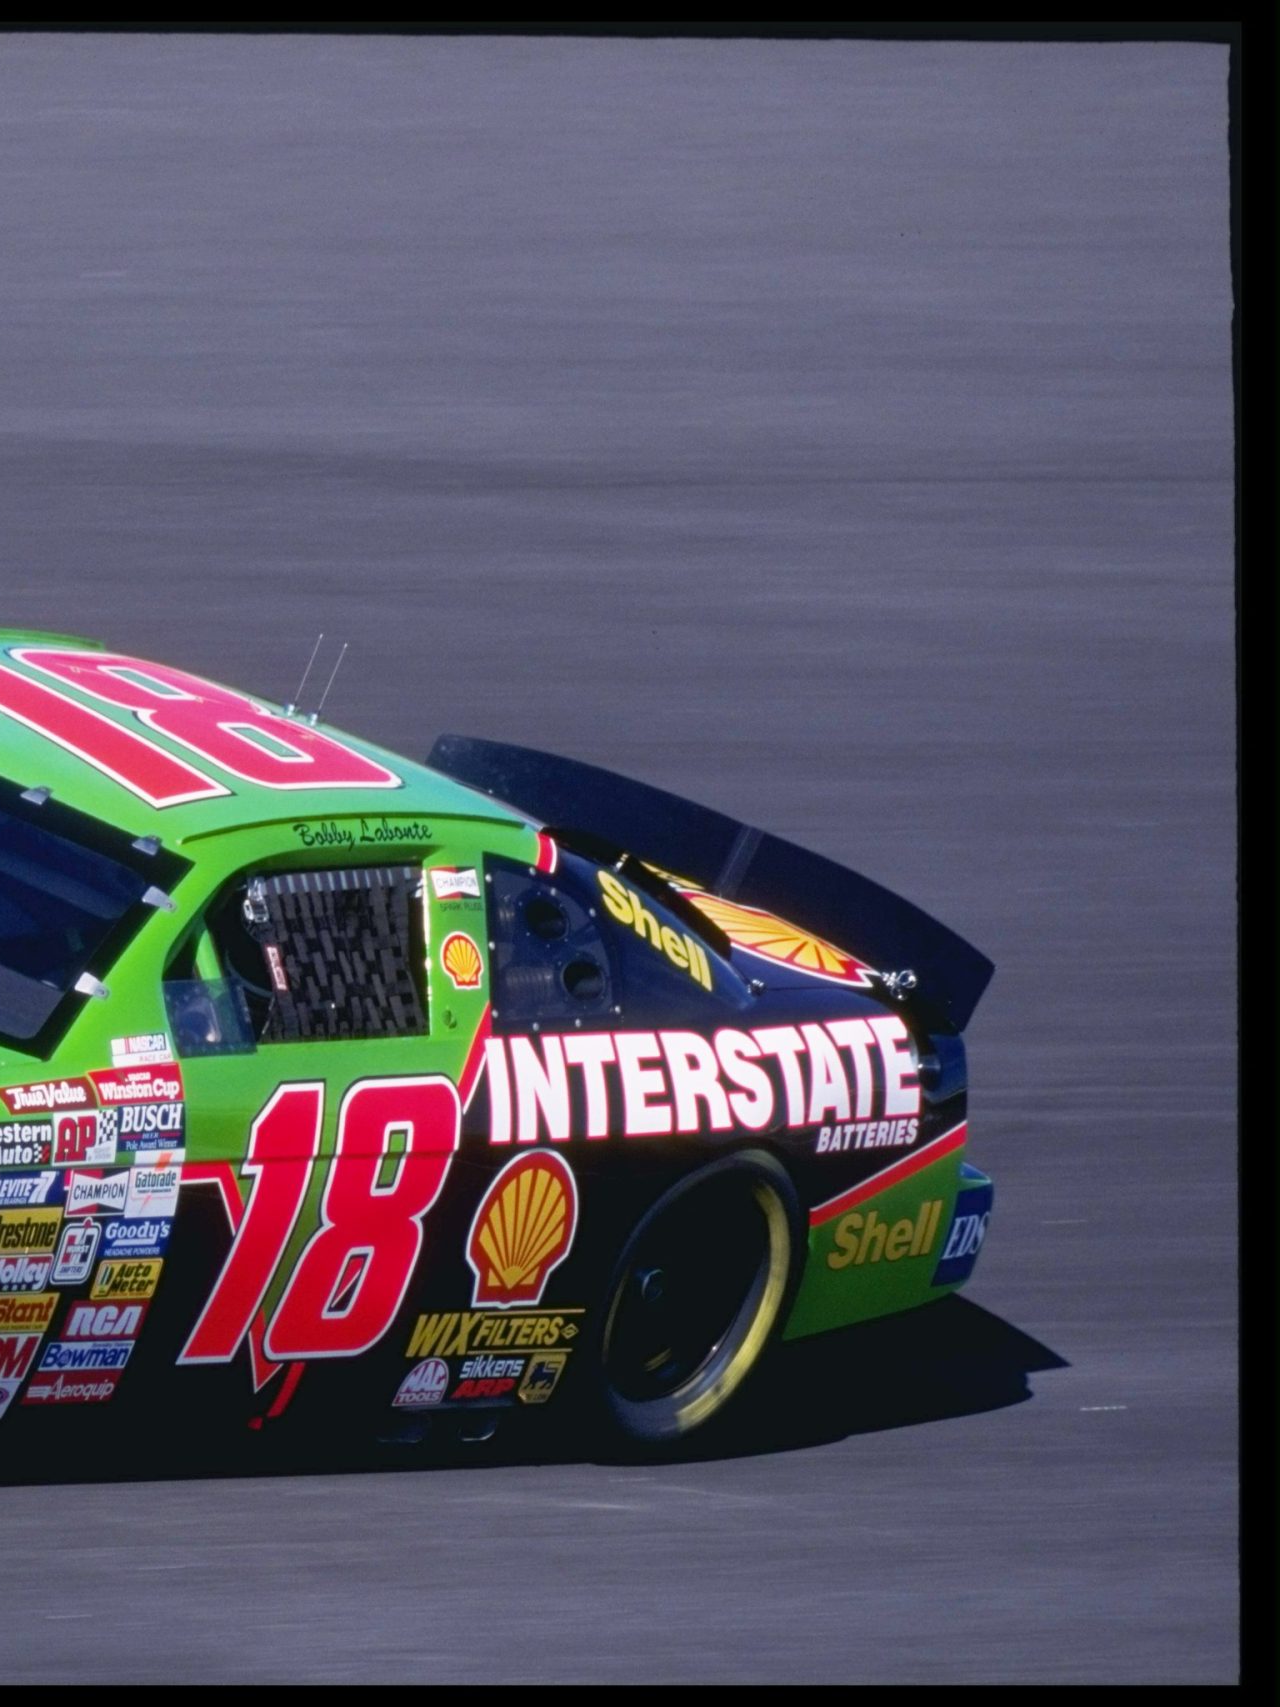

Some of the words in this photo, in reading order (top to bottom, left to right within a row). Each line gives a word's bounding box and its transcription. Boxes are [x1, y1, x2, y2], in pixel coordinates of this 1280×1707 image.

[292, 821, 355, 851] Bobby
[360, 818, 432, 842] Labonte
[436, 876, 477, 889] CHAMPION
[596, 868, 713, 991] Shell
[128, 1035, 165, 1053] NASCAR
[484, 1015, 920, 1145] INTERSTATE
[120, 1103, 183, 1133] BUSCH
[55, 1115, 97, 1163] AP
[816, 1118, 919, 1154] BATTERIES
[73, 1183, 126, 1201] CHAMPION
[135, 1170, 177, 1188] Gatorade
[105, 1220, 171, 1241] Goody's
[175, 1073, 462, 1365] 18
[827, 1200, 943, 1270] Shell
[941, 1211, 991, 1261] EDS
[116, 1263, 152, 1278] Auto
[110, 1278, 155, 1293] Meter
[66, 1305, 143, 1337] RCA
[405, 1312, 480, 1357] WIX
[471, 1316, 565, 1347] FILTERS
[41, 1343, 127, 1369] Bowman
[459, 1355, 525, 1379] sikkens
[50, 1374, 115, 1400] Aeroquip
[405, 1361, 448, 1392] MAC
[451, 1378, 516, 1398] ARP
[398, 1390, 442, 1401] TOOLS
